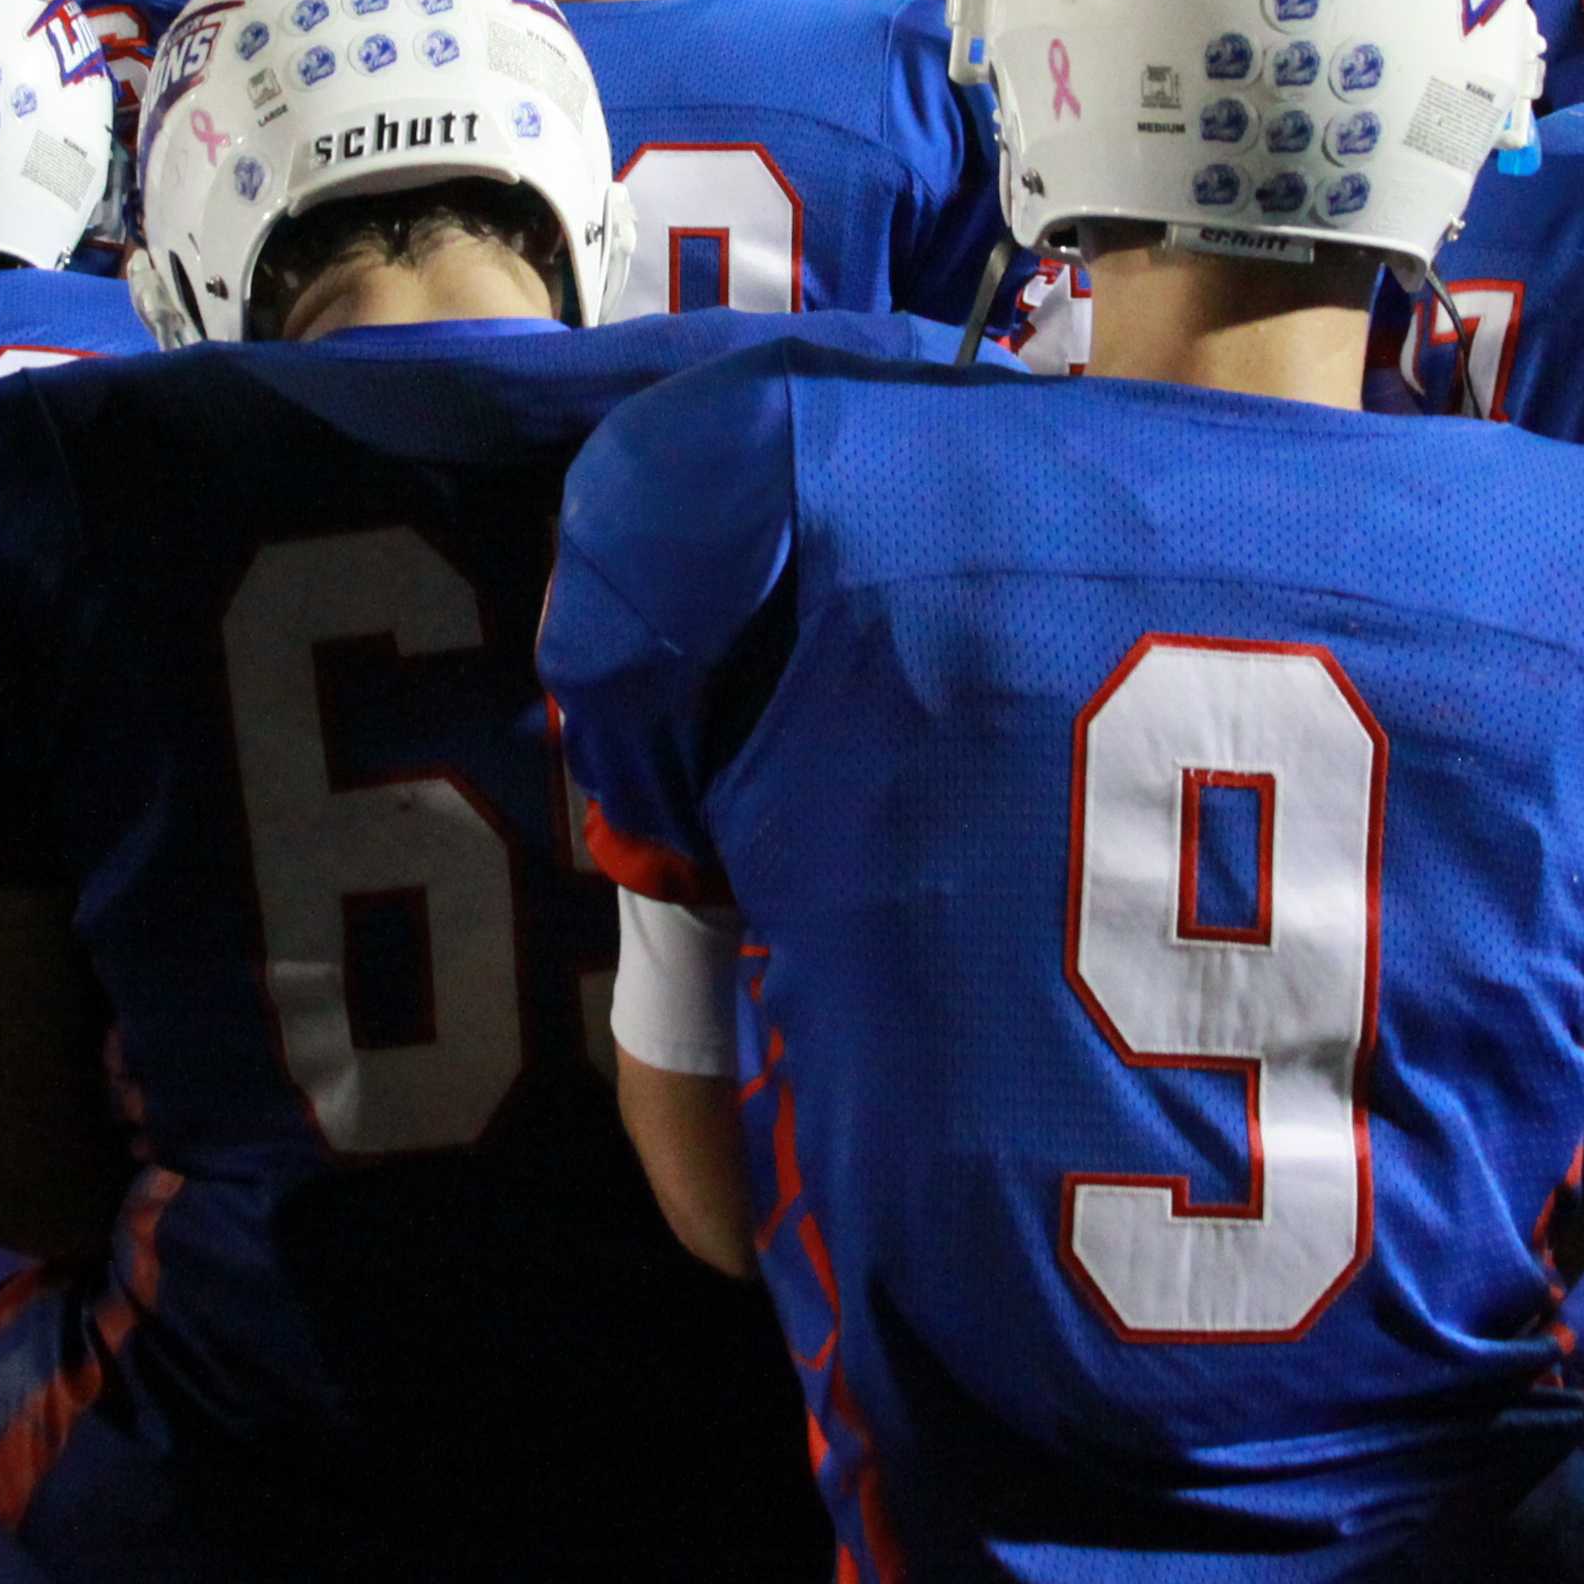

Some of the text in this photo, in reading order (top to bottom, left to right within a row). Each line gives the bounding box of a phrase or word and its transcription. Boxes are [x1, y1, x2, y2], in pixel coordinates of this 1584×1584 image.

[257, 104, 289, 127] LARGE
[1137, 122, 1186, 135] MEDIUM
[312, 111, 481, 167] schutt
[1059, 631, 1390, 1346] 9
